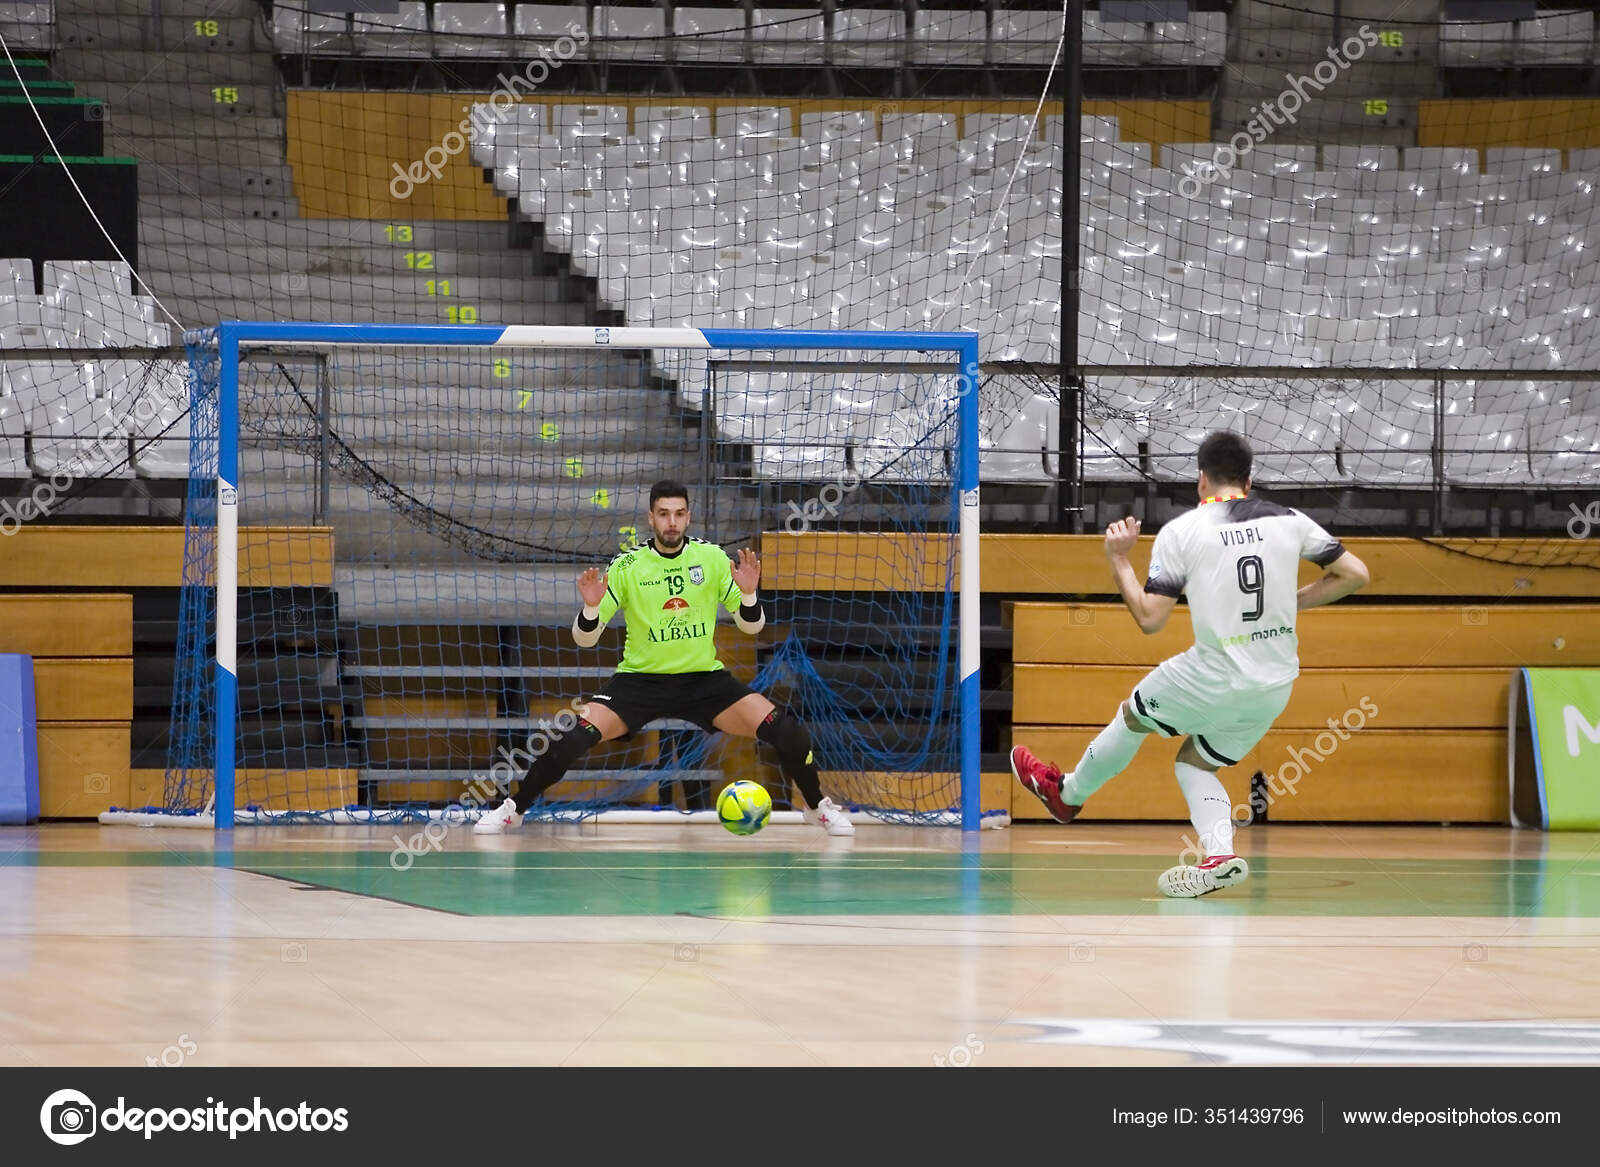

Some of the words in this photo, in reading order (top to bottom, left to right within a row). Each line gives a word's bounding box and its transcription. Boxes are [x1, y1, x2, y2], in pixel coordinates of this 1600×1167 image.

[211, 87, 239, 105] 15
[1361, 99, 1388, 116] 15
[384, 225, 413, 243] 13
[403, 252, 434, 270] 12
[424, 279, 451, 297] 11
[445, 305, 477, 325] 10
[517, 390, 533, 409] 7
[1219, 527, 1264, 547] VIDAL
[664, 575, 685, 596] 19
[1236, 554, 1266, 623] 9
[647, 622, 707, 643] ALBALI
